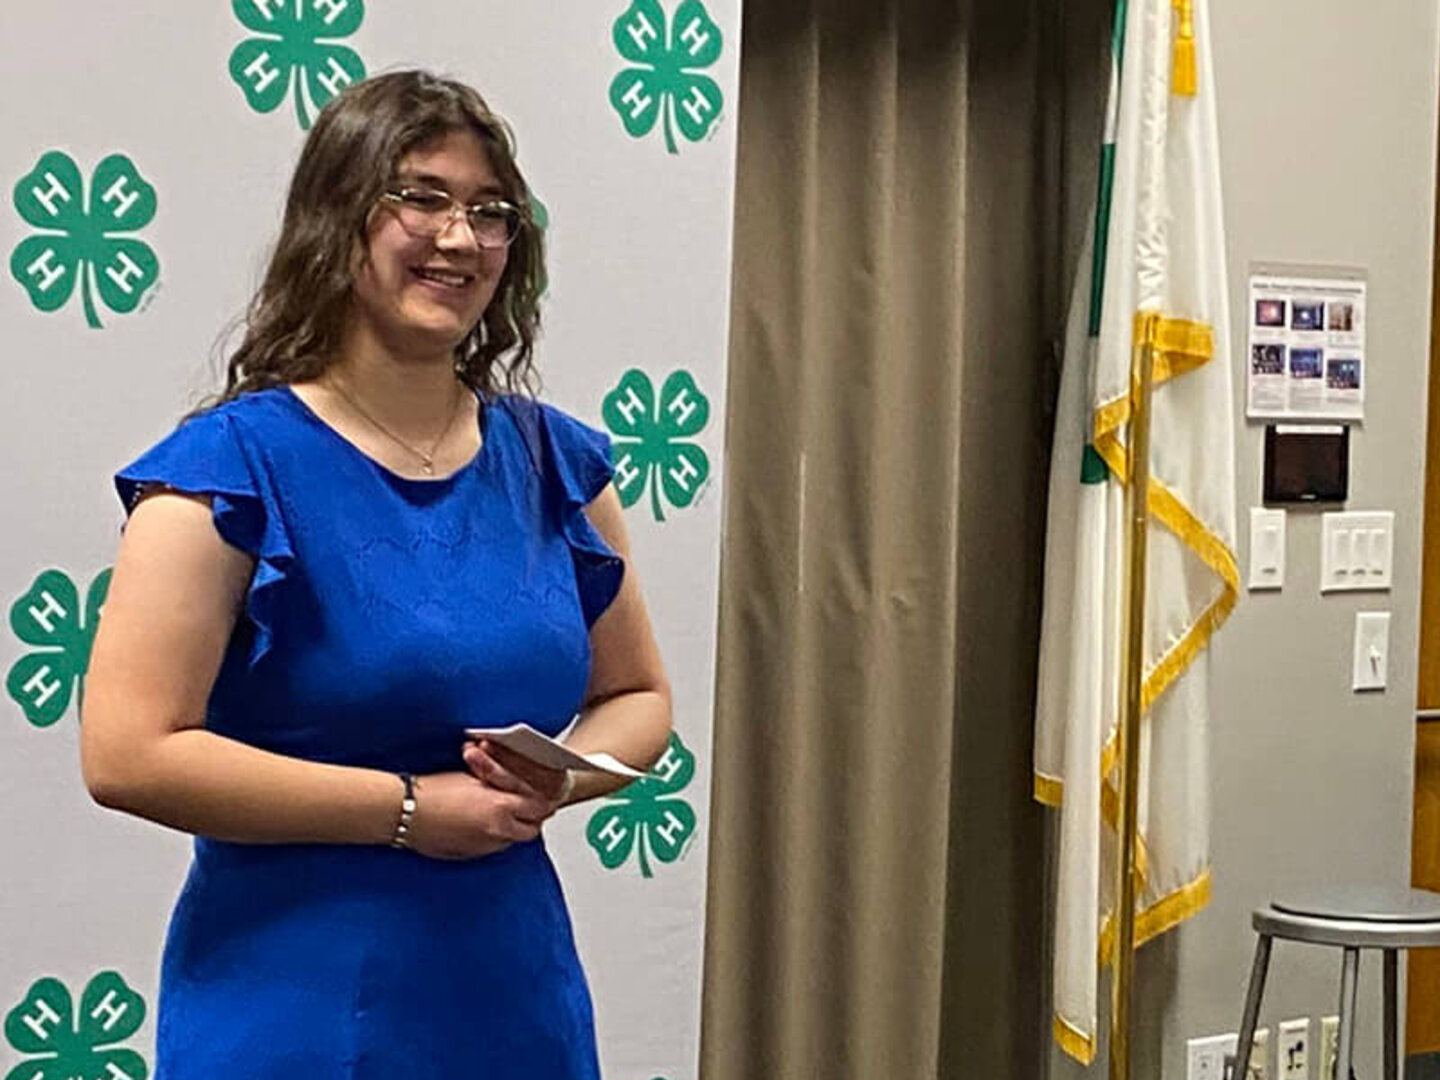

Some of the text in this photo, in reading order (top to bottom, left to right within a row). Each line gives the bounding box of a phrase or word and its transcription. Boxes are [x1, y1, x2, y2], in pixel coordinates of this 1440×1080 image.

[627, 11, 657, 51] H
[681, 17, 709, 56] H
[243, 51, 279, 93] H
[317, 57, 352, 97] H
[621, 80, 652, 119] H
[682, 86, 711, 124] H
[32, 172, 70, 216] H
[102, 175, 140, 218] H
[26, 249, 65, 292] H
[105, 252, 143, 294] H
[616, 386, 646, 425] H
[668, 388, 697, 426] H
[669, 453, 698, 491] H
[28, 590, 67, 632] H
[22, 665, 61, 708] H
[654, 746, 683, 783] H
[598, 815, 627, 852] H
[656, 810, 684, 846] H
[22, 999, 61, 1040] H
[91, 989, 128, 1031] H
